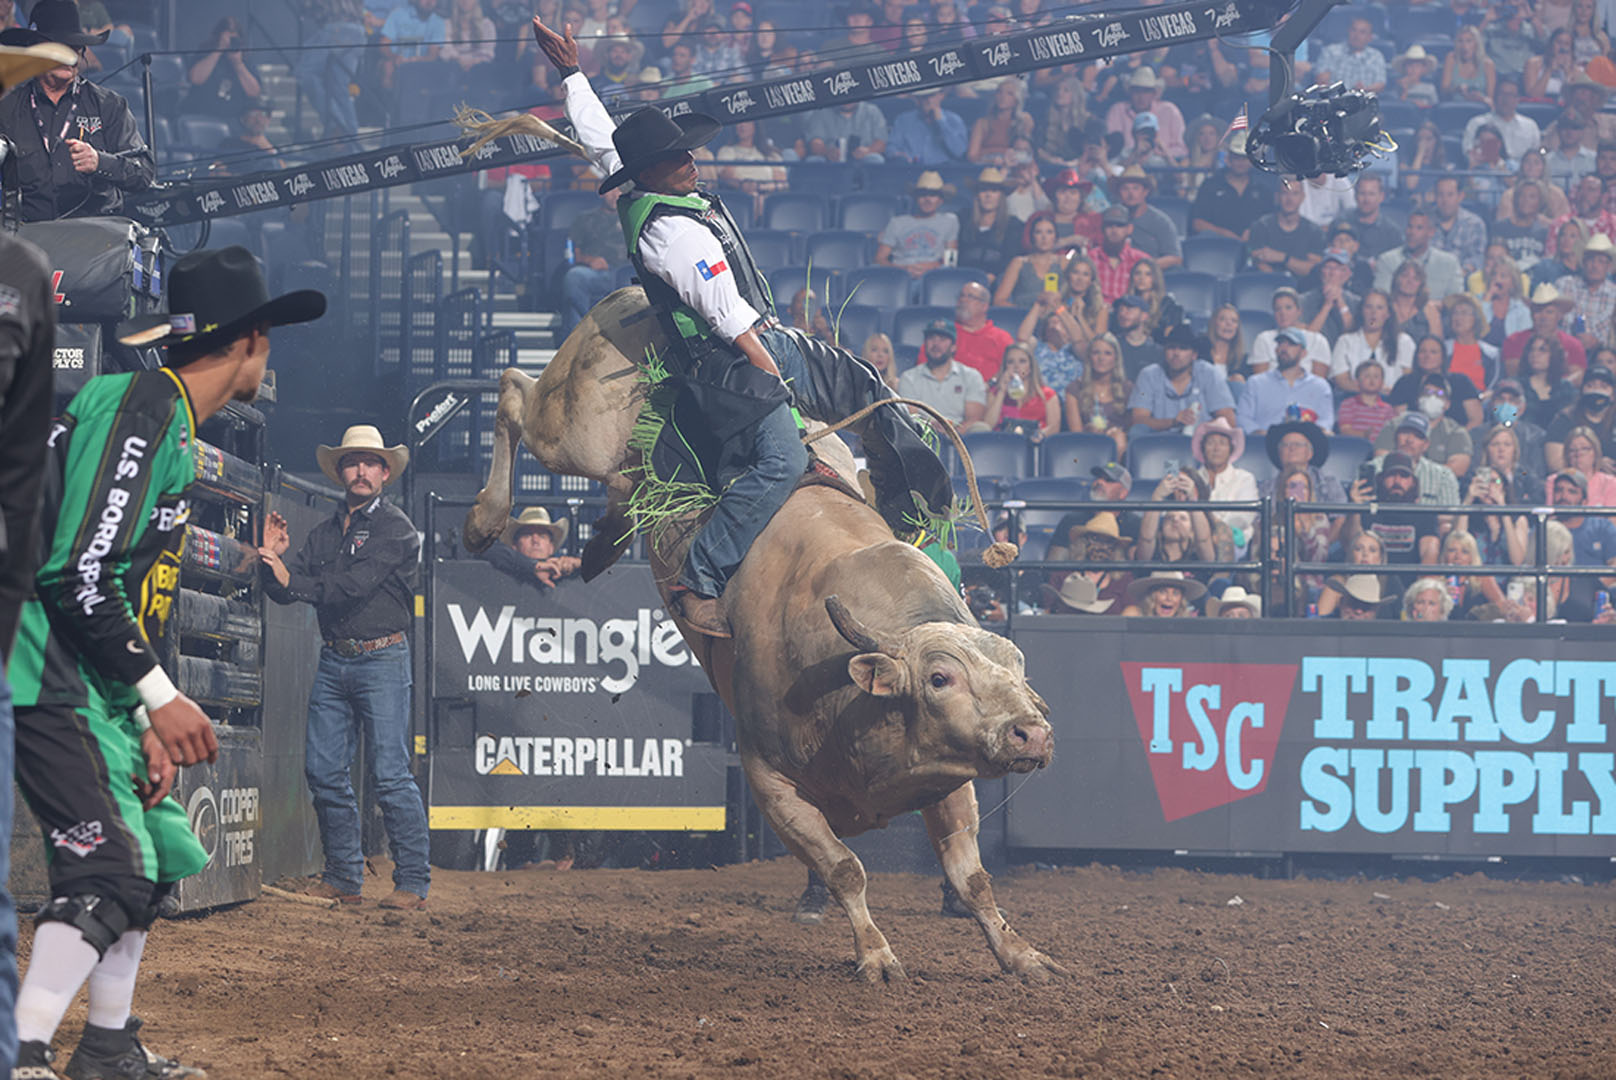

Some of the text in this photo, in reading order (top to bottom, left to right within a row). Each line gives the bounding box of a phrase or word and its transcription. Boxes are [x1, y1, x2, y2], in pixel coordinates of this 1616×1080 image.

[1158, 11, 1196, 39] VEGAS
[1050, 31, 1083, 58] VEGAS
[885, 60, 921, 87] VEGAS
[781, 79, 815, 105] VEGAS
[431, 144, 463, 169] VEGAS
[338, 163, 369, 187] VEGAS
[250, 180, 279, 204] VEGAS
[468, 675, 501, 691] LONG
[503, 675, 532, 692] LIVE
[1141, 667, 1265, 791] TSC
[475, 736, 684, 777] CATERPILLAR
[1300, 745, 1616, 835] SUPPLY
[220, 787, 259, 825] COOPER
[225, 829, 254, 868] TIRES
